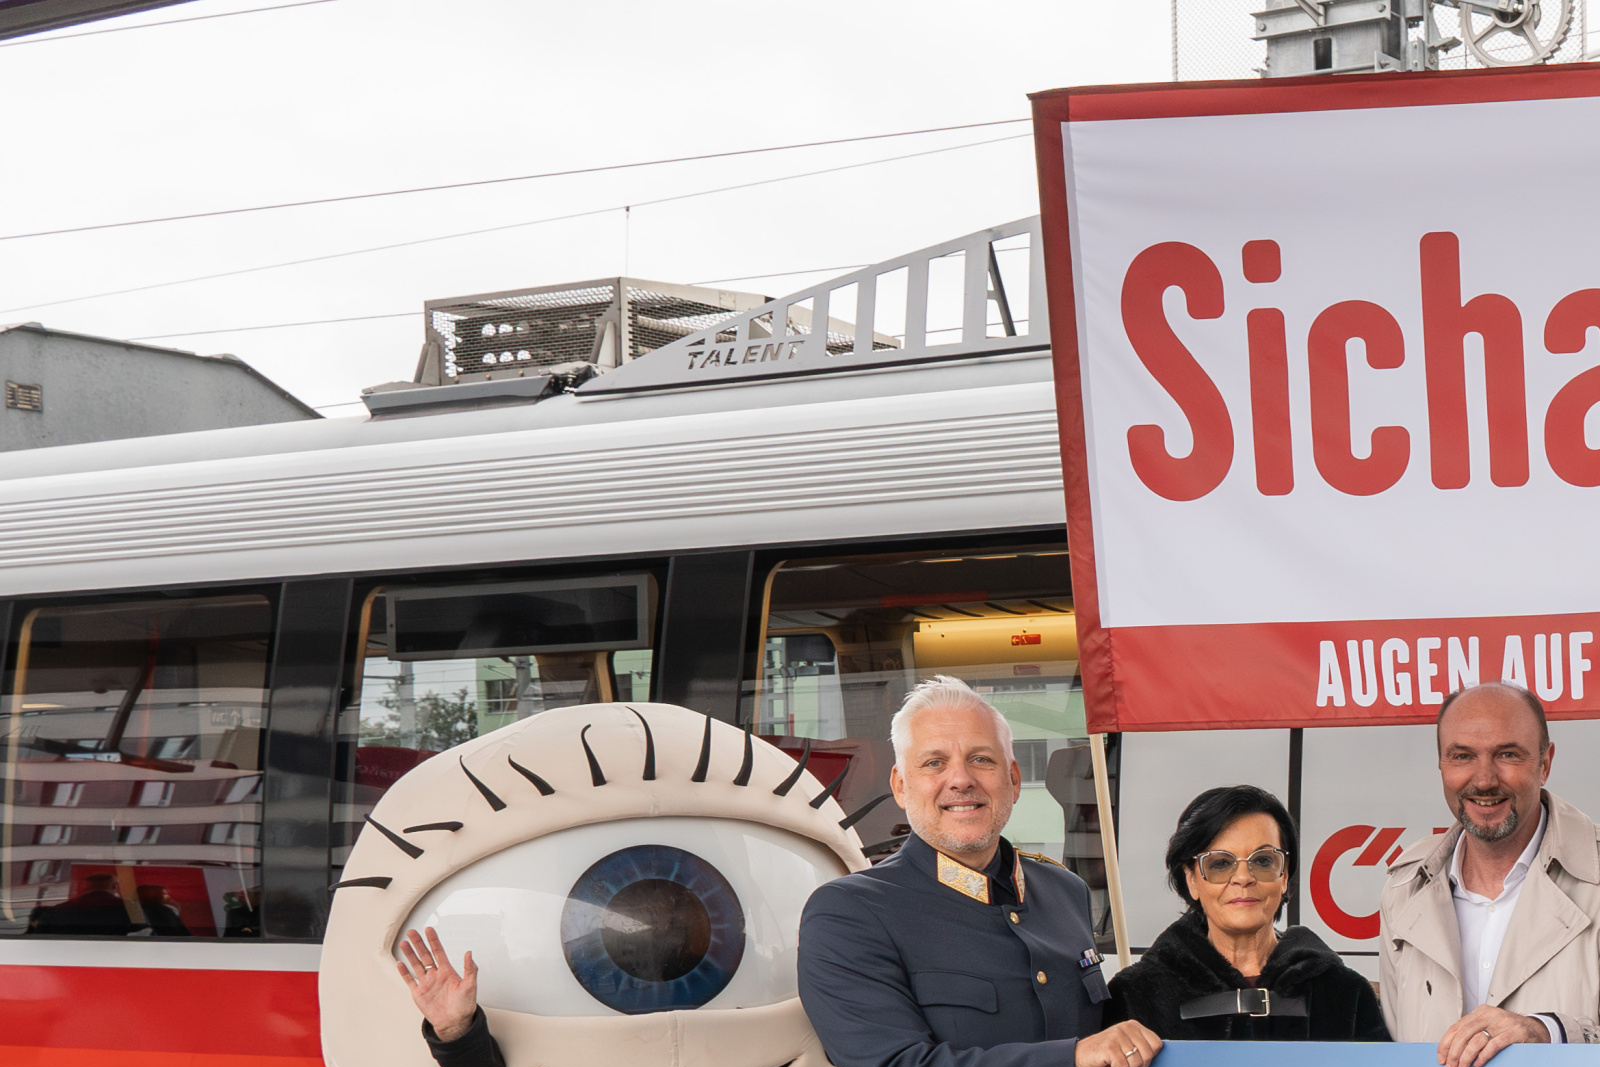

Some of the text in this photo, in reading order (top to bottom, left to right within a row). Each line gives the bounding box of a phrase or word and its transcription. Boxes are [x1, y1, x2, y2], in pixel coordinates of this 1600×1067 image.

[687, 340, 806, 370] TALENT
[1316, 636, 1481, 707] AUGEN
[1500, 631, 1594, 702] AUF
